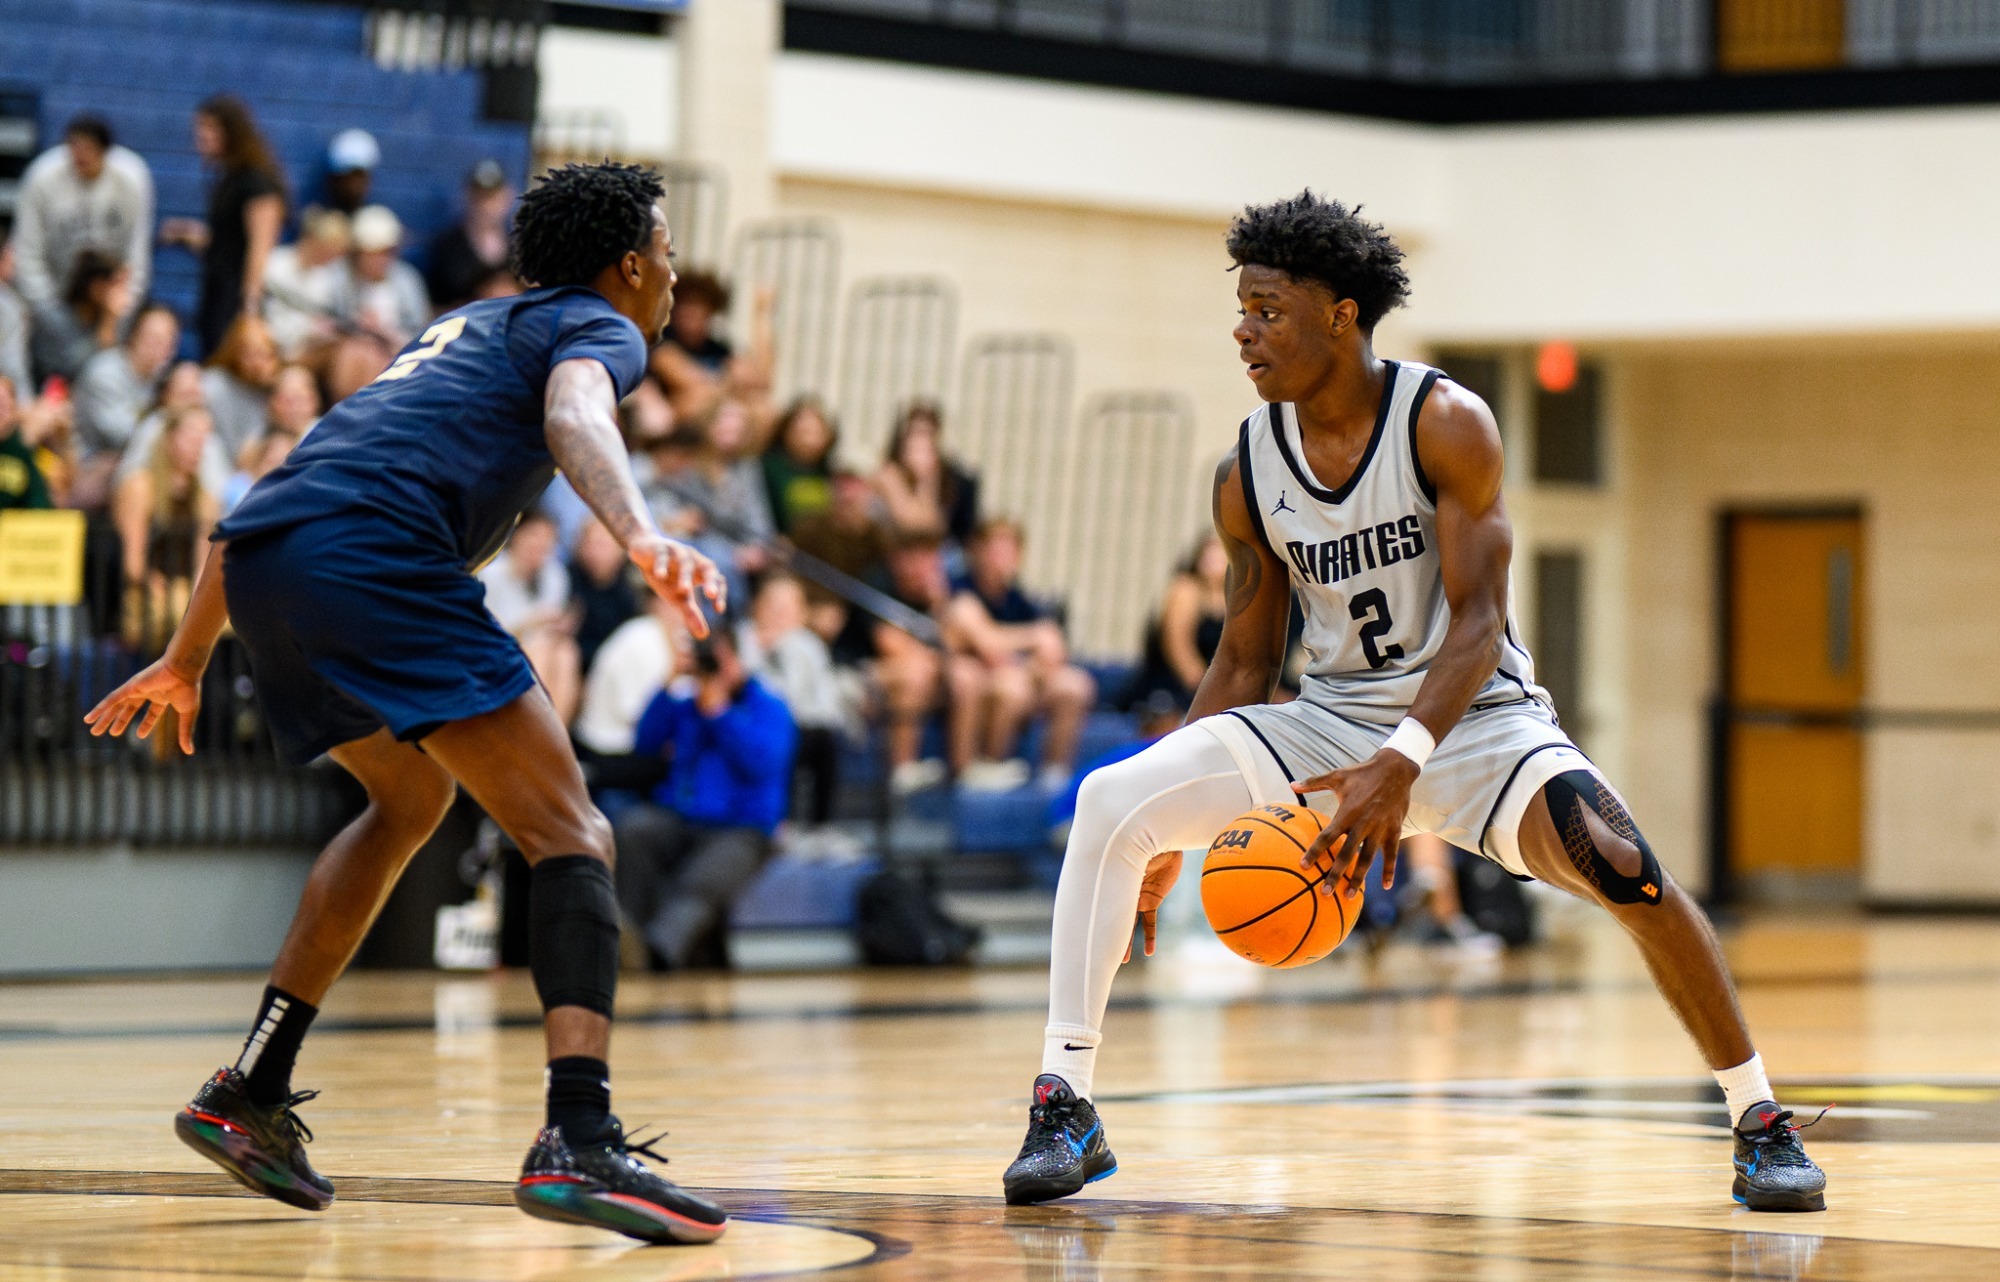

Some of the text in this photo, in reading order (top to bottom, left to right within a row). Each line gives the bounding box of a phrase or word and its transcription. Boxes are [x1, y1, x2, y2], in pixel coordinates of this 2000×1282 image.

[371, 316, 467, 384] 2
[1286, 515, 1426, 584] PIRATES
[1348, 587, 1405, 669] 2
